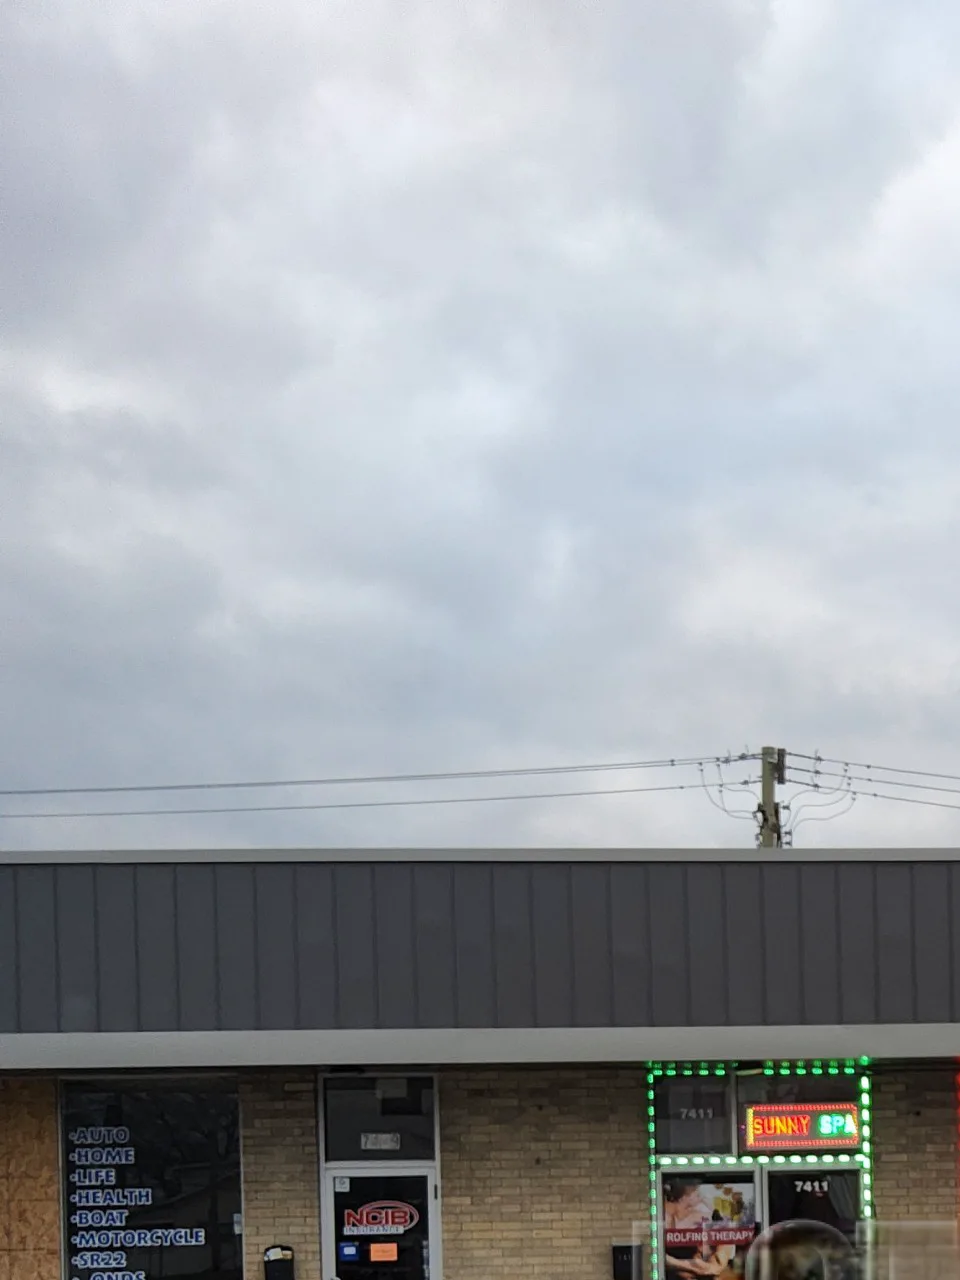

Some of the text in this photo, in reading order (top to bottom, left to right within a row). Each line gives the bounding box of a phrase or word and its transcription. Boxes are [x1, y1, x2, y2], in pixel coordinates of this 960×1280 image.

[679, 1108, 715, 1120] 7411
[753, 1113, 858, 1136] SUNNY SPA
[74, 1126, 130, 1144] AUTO
[75, 1147, 135, 1165] HOME
[76, 1168, 116, 1186] LIFE
[794, 1180, 829, 1193] 7411
[76, 1188, 152, 1206] HEALTH
[76, 1209, 129, 1228] BOAT
[344, 1208, 411, 1227] NCIB
[77, 1228, 206, 1249] MOTORCYCLE
[666, 1228, 756, 1243] ROLFING THERAPY
[77, 1252, 127, 1268] SR22
